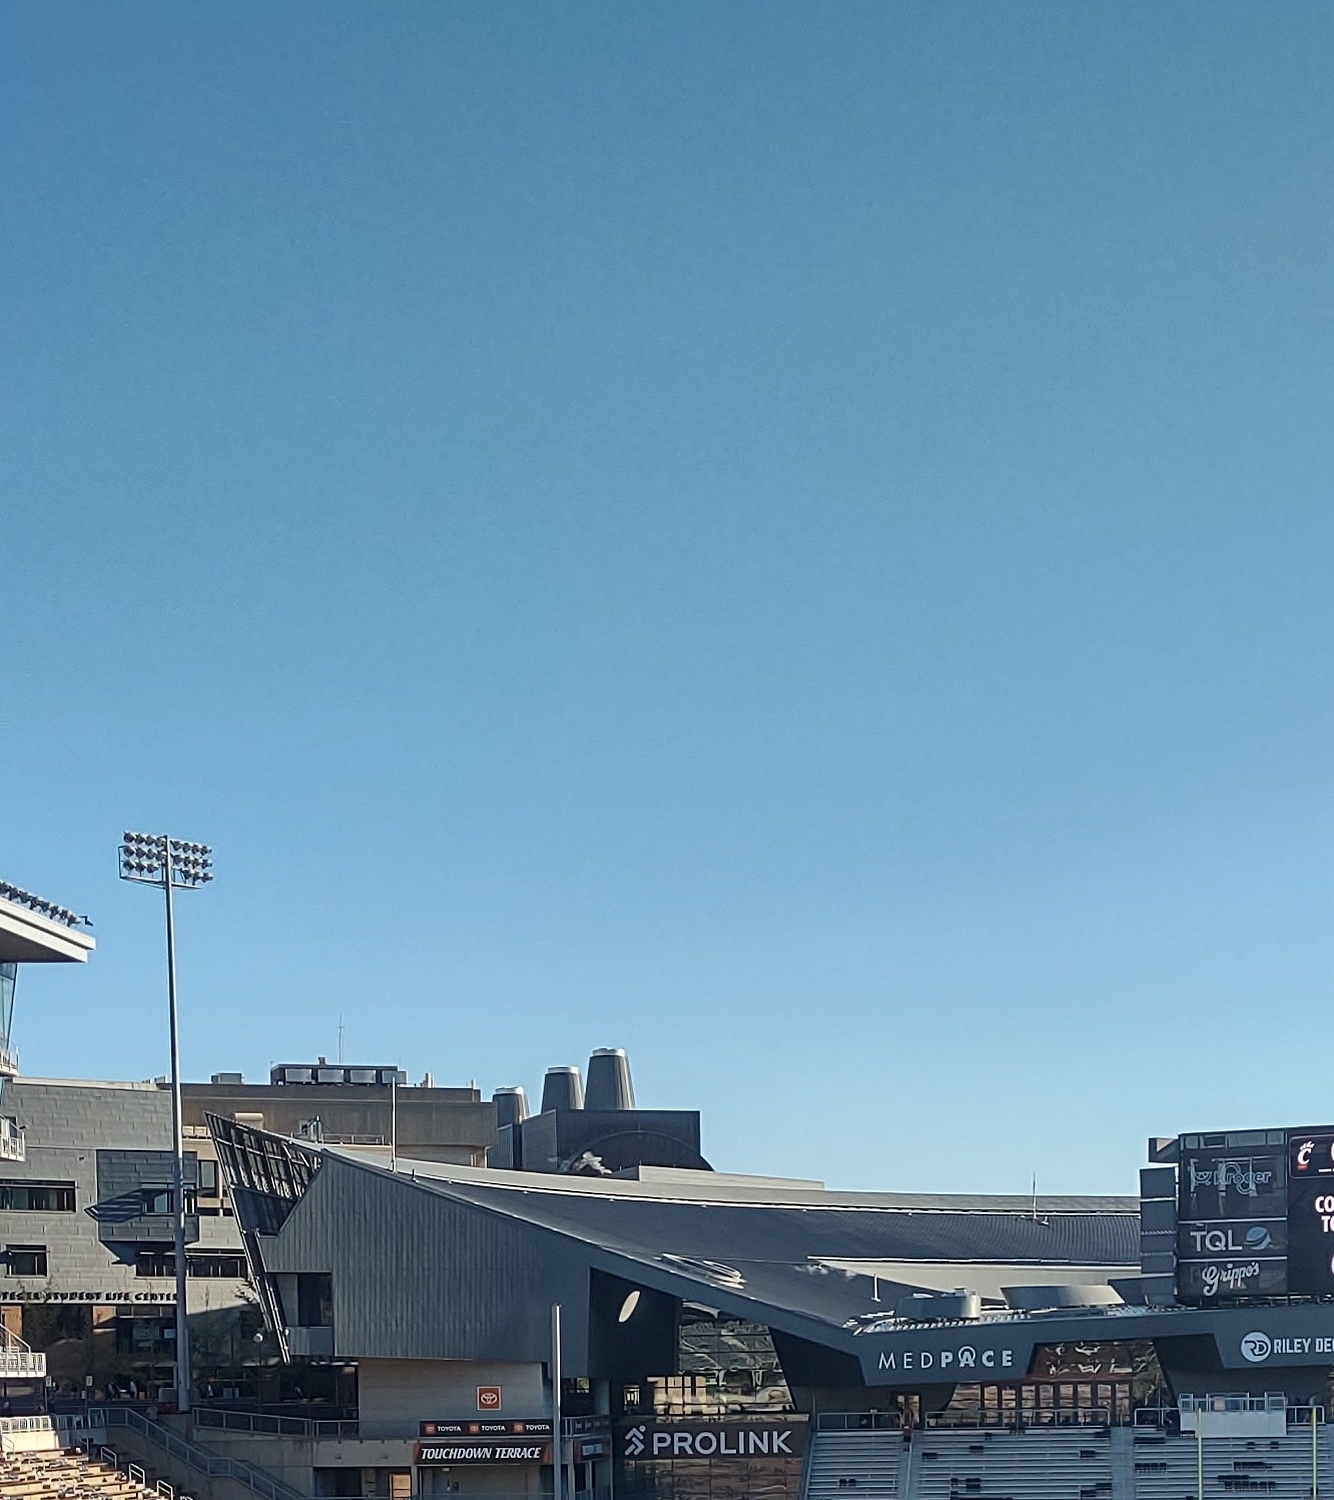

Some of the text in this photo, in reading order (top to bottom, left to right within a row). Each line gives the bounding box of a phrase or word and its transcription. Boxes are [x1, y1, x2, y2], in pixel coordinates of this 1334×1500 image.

[1214, 1161, 1272, 1196] Kroger
[1190, 1229, 1244, 1252] TQL
[105, 1291, 131, 1302] LIFE
[1273, 1338, 1311, 1354] RILEY
[878, 1345, 1014, 1371] MEDPACE
[437, 1425, 462, 1433] TOYOTA
[652, 1429, 793, 1456] PROLINK
[421, 1447, 542, 1460] TOUCHDOWN TERRACE
